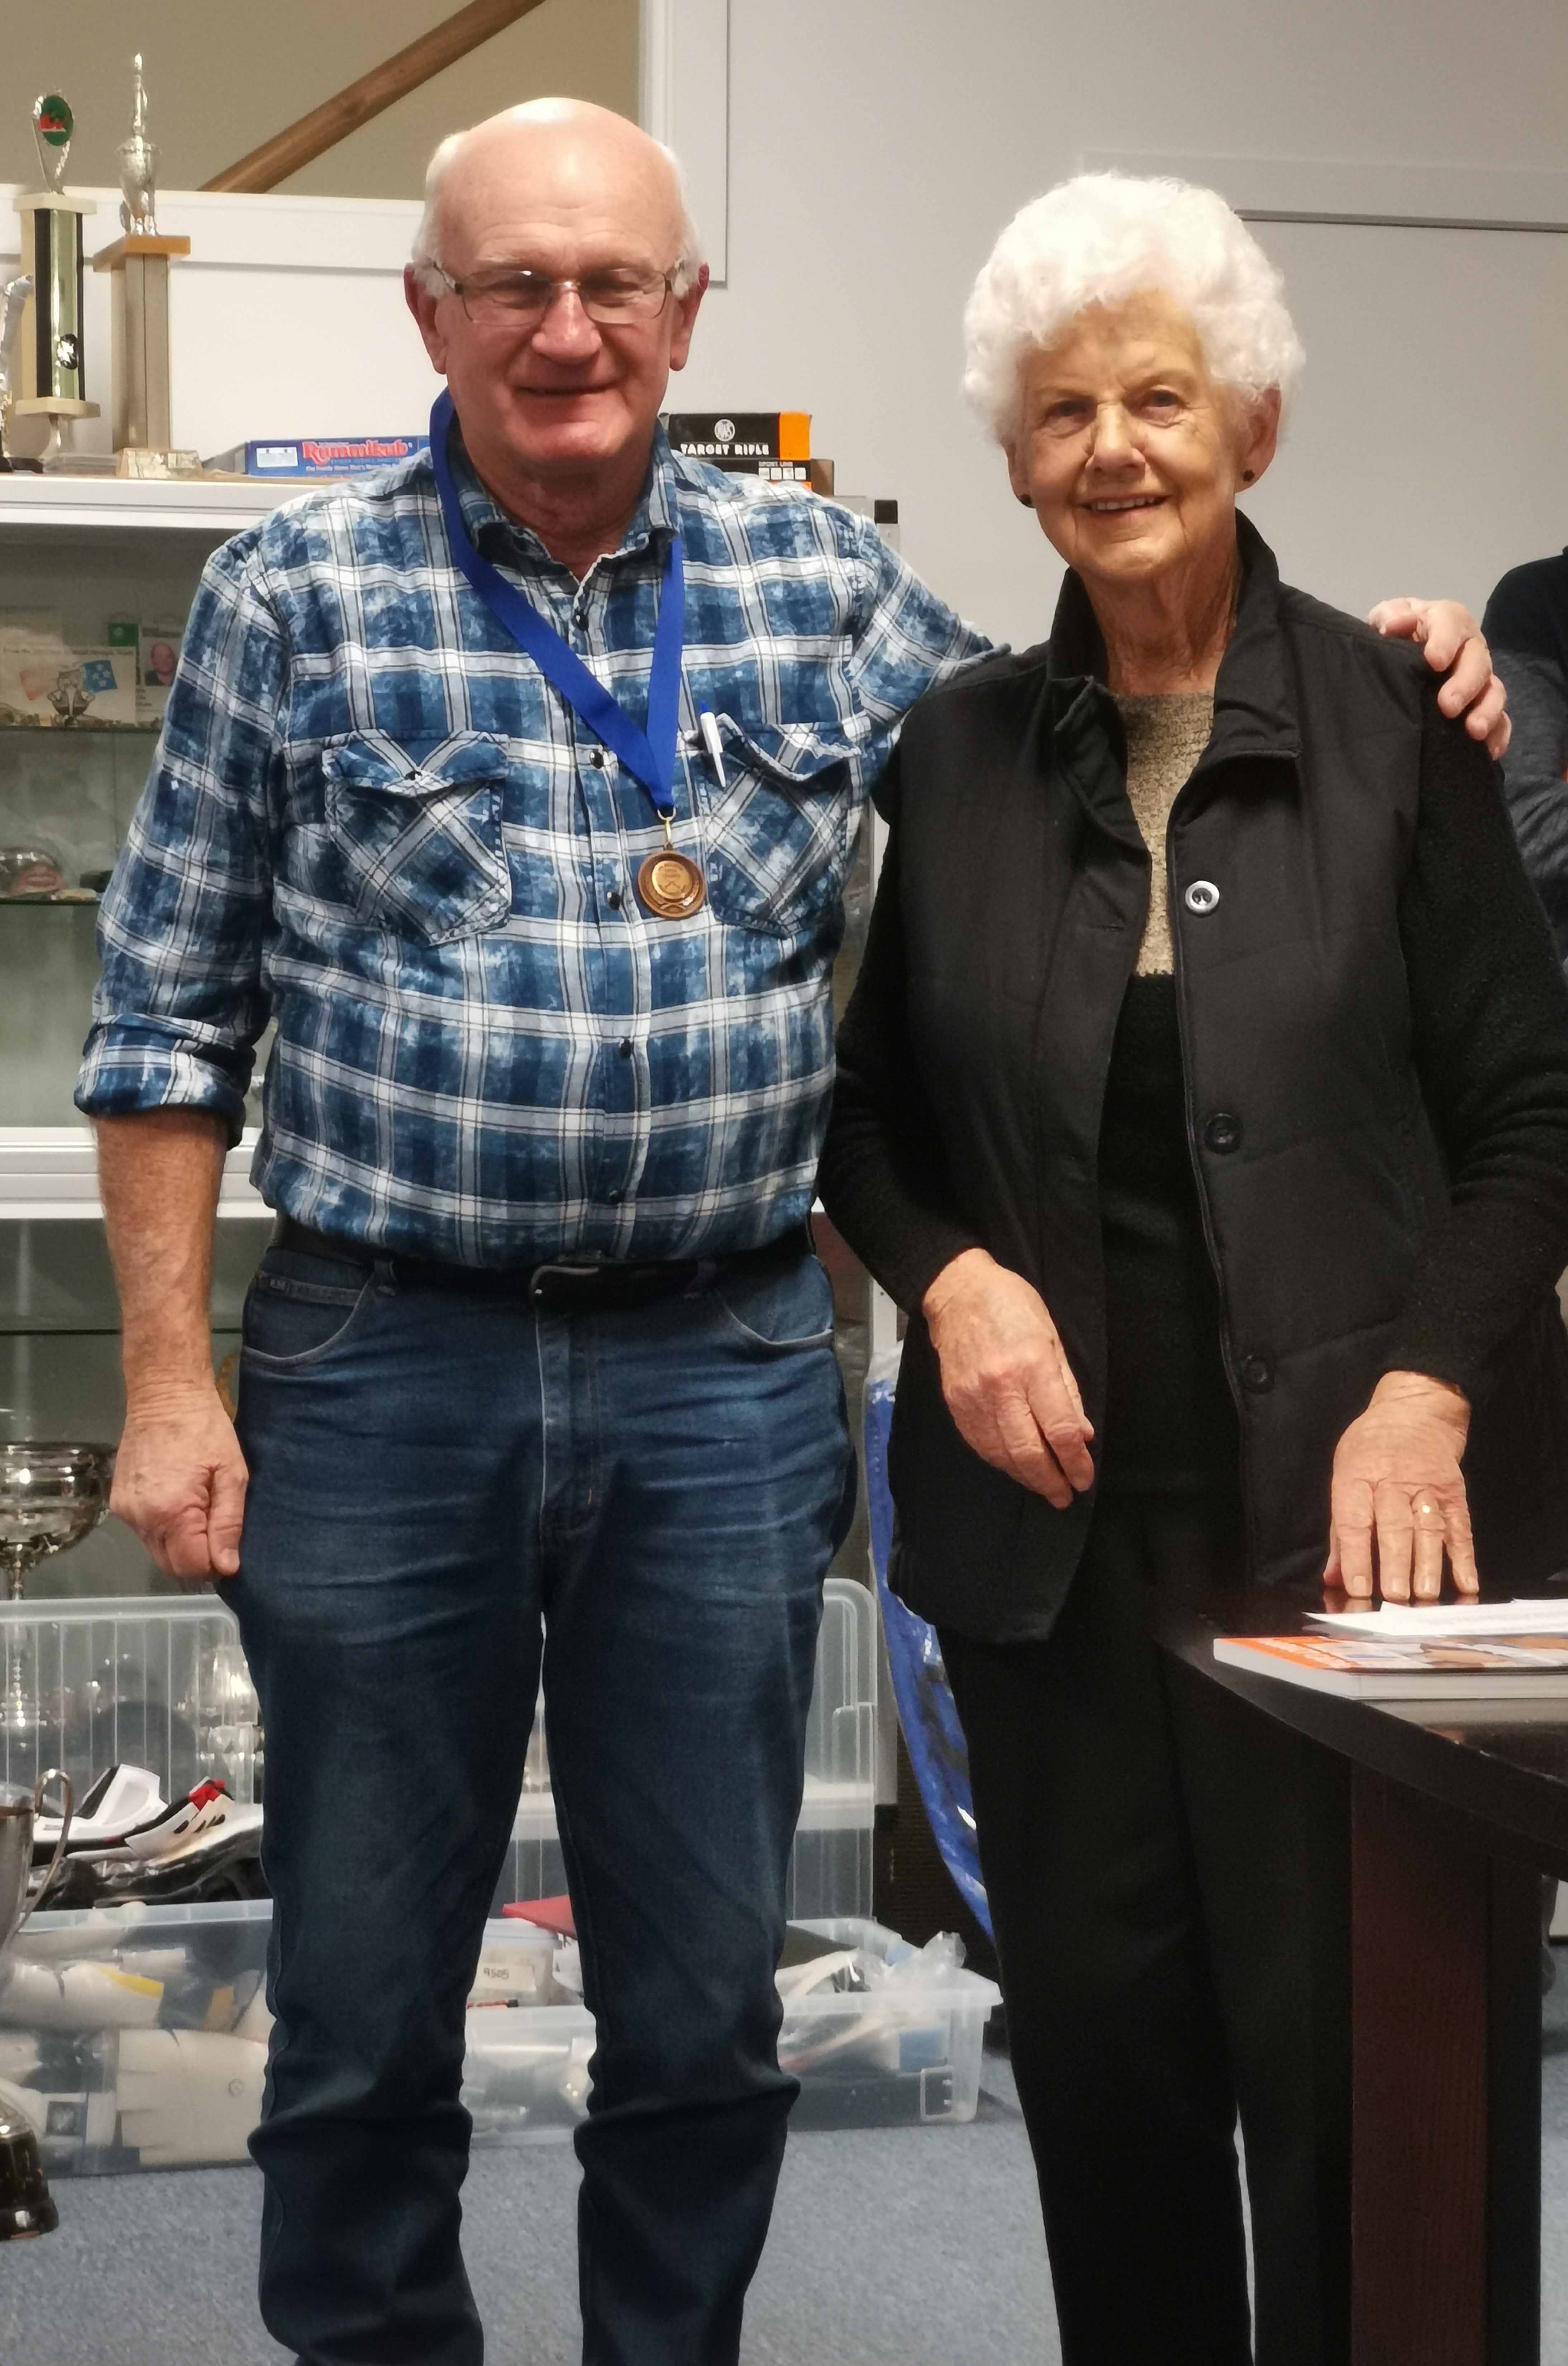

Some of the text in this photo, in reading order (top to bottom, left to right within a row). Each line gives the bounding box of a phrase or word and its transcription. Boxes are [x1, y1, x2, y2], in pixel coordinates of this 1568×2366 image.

[302, 439, 409, 466] Rummikub
[680, 443, 769, 456] TARGET RIFLE
